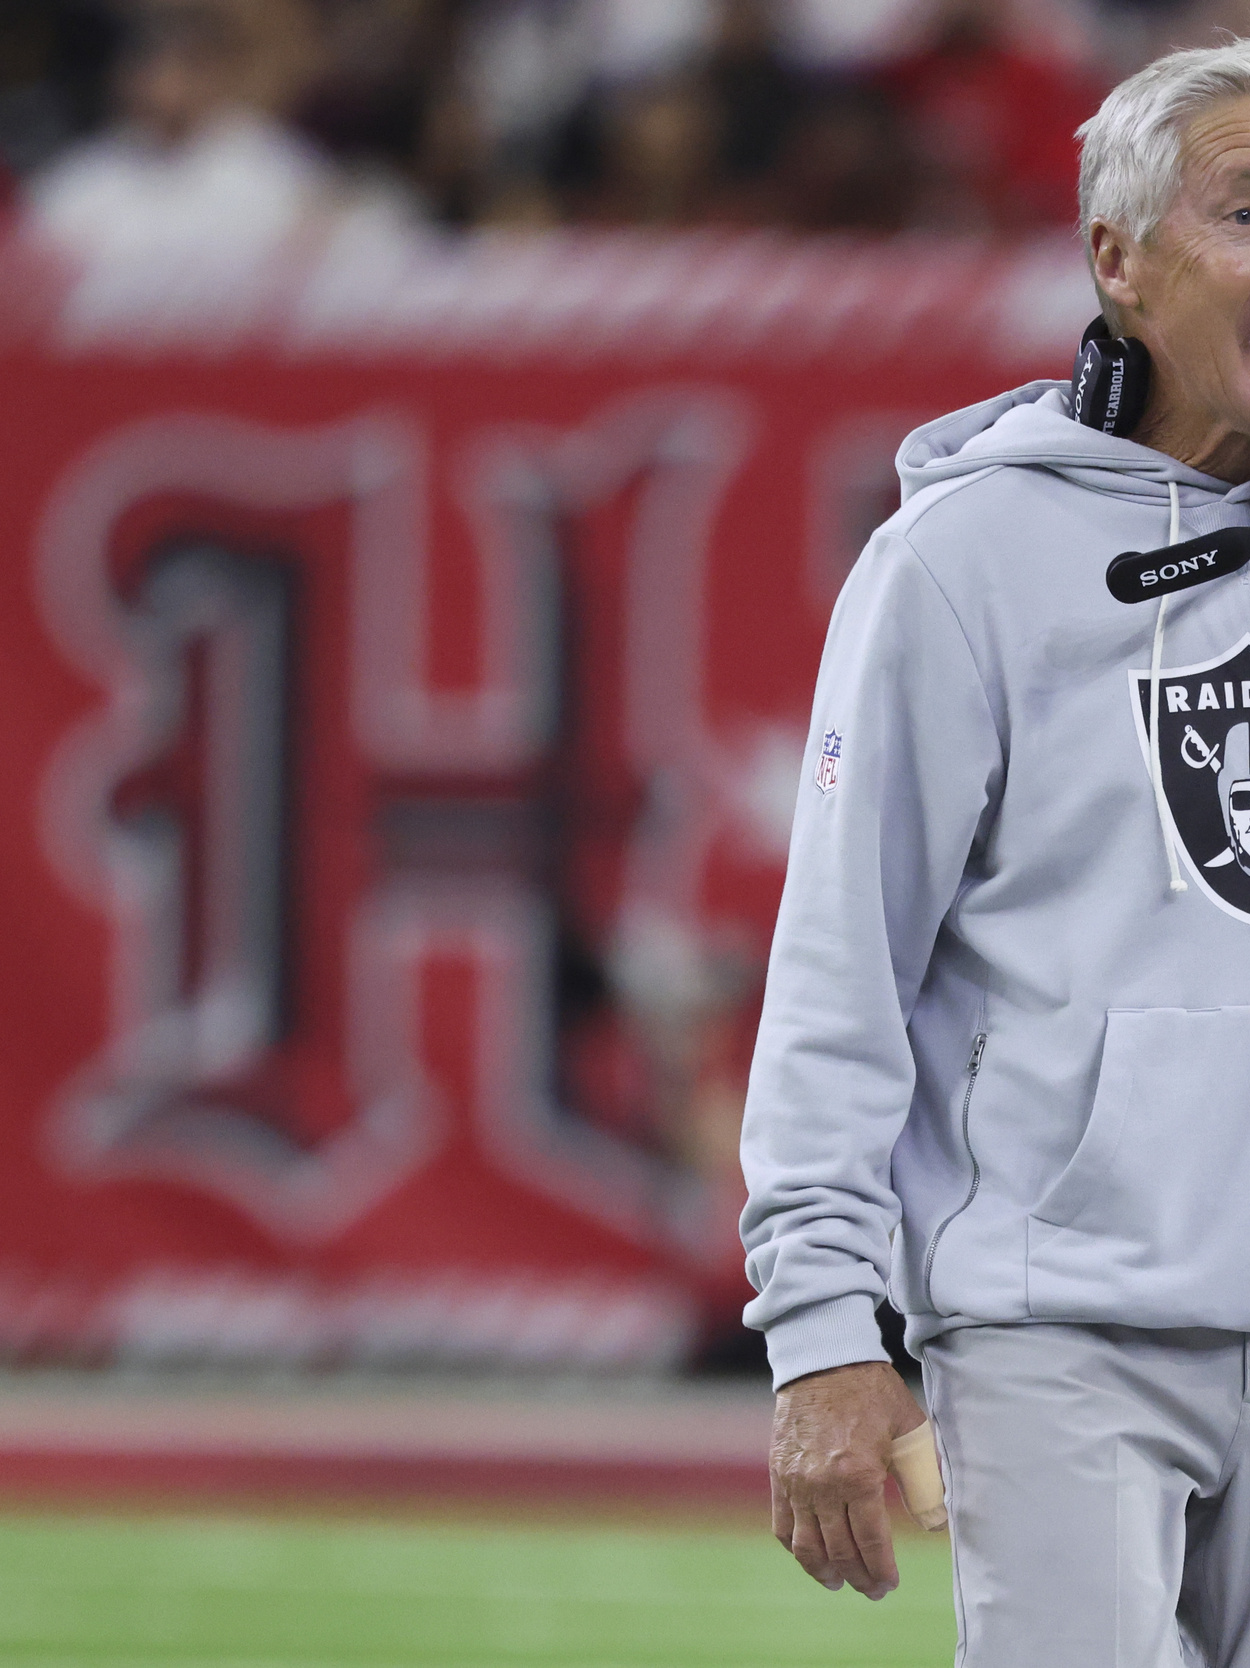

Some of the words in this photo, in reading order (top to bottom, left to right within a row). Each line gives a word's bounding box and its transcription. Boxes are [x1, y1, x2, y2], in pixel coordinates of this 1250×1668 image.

[1106, 357, 1124, 418] CARROLL
[1139, 549, 1219, 588] SONY
[817, 755, 837, 787] NFL
